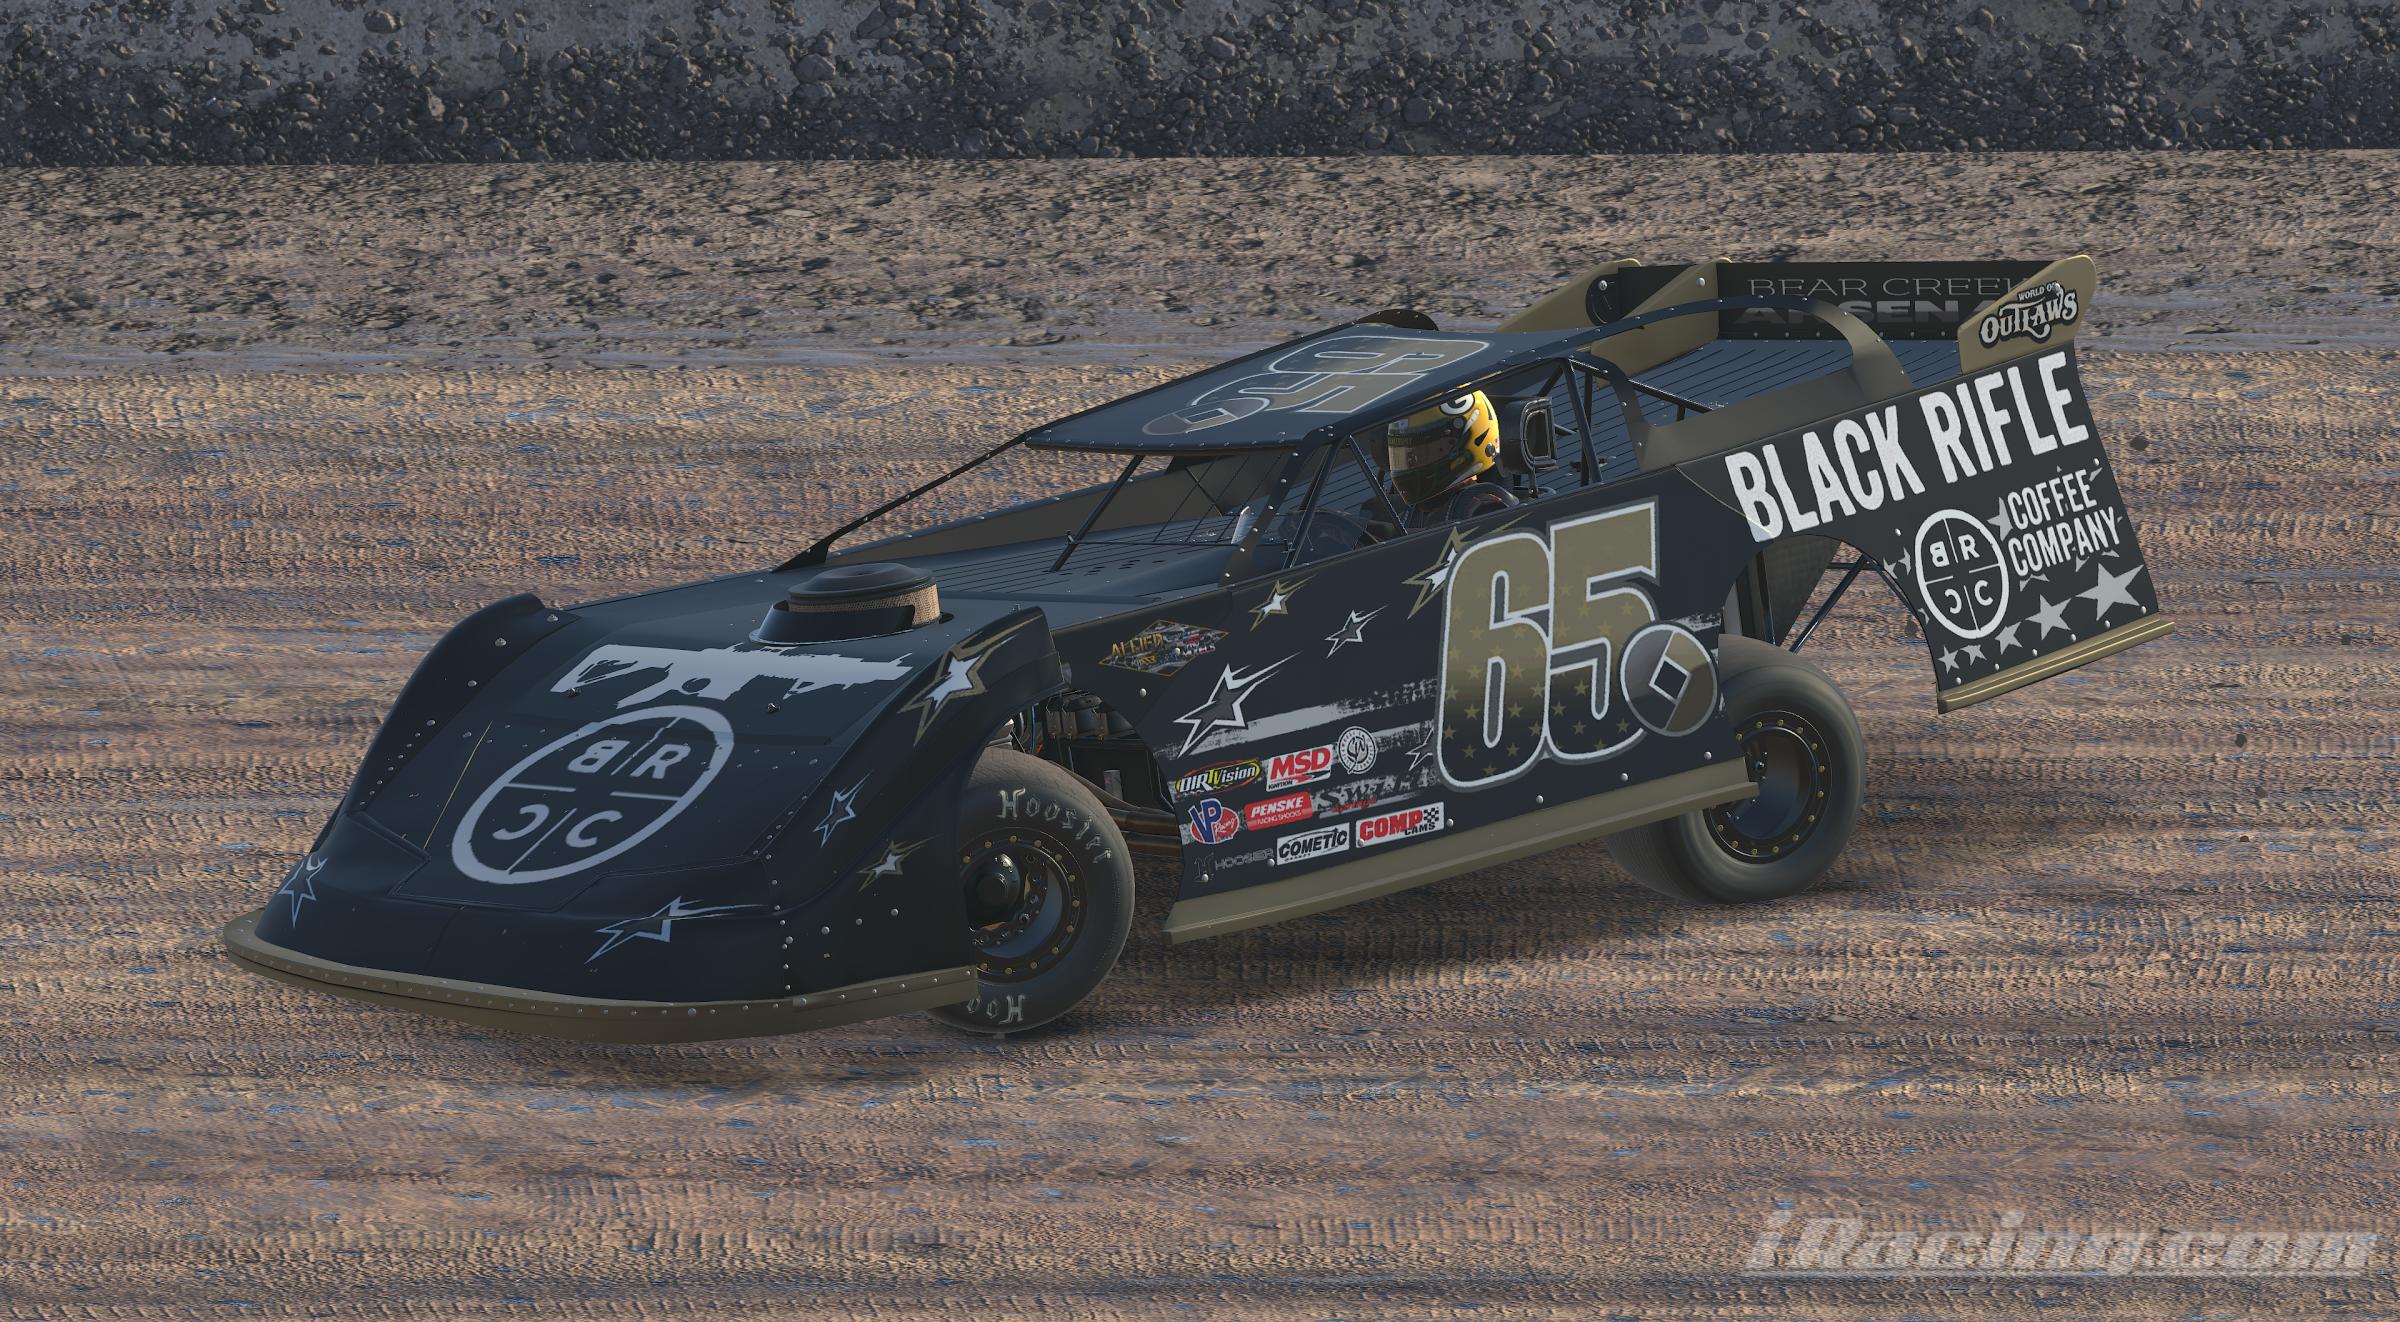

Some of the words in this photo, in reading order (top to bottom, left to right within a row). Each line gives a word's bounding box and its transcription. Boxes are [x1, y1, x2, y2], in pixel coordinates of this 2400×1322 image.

[1747, 277, 1868, 297] BEAR
[2018, 286, 2045, 301] WORLD
[1980, 286, 2078, 344] OUTLAWS
[1724, 405, 1926, 543] BLACK
[1918, 351, 2090, 484] RIFLE
[2007, 469, 2097, 530] COFFEE
[2008, 506, 2120, 577] COMPANY
[1437, 501, 1657, 788] 65
[1270, 747, 1331, 781] MSD
[1188, 798, 1222, 844] VP
[1251, 797, 1304, 818] PENSKE
[1360, 810, 1423, 841] COMP
[1404, 822, 1436, 836] CAMS
[1279, 828, 1348, 859] COMETIC
